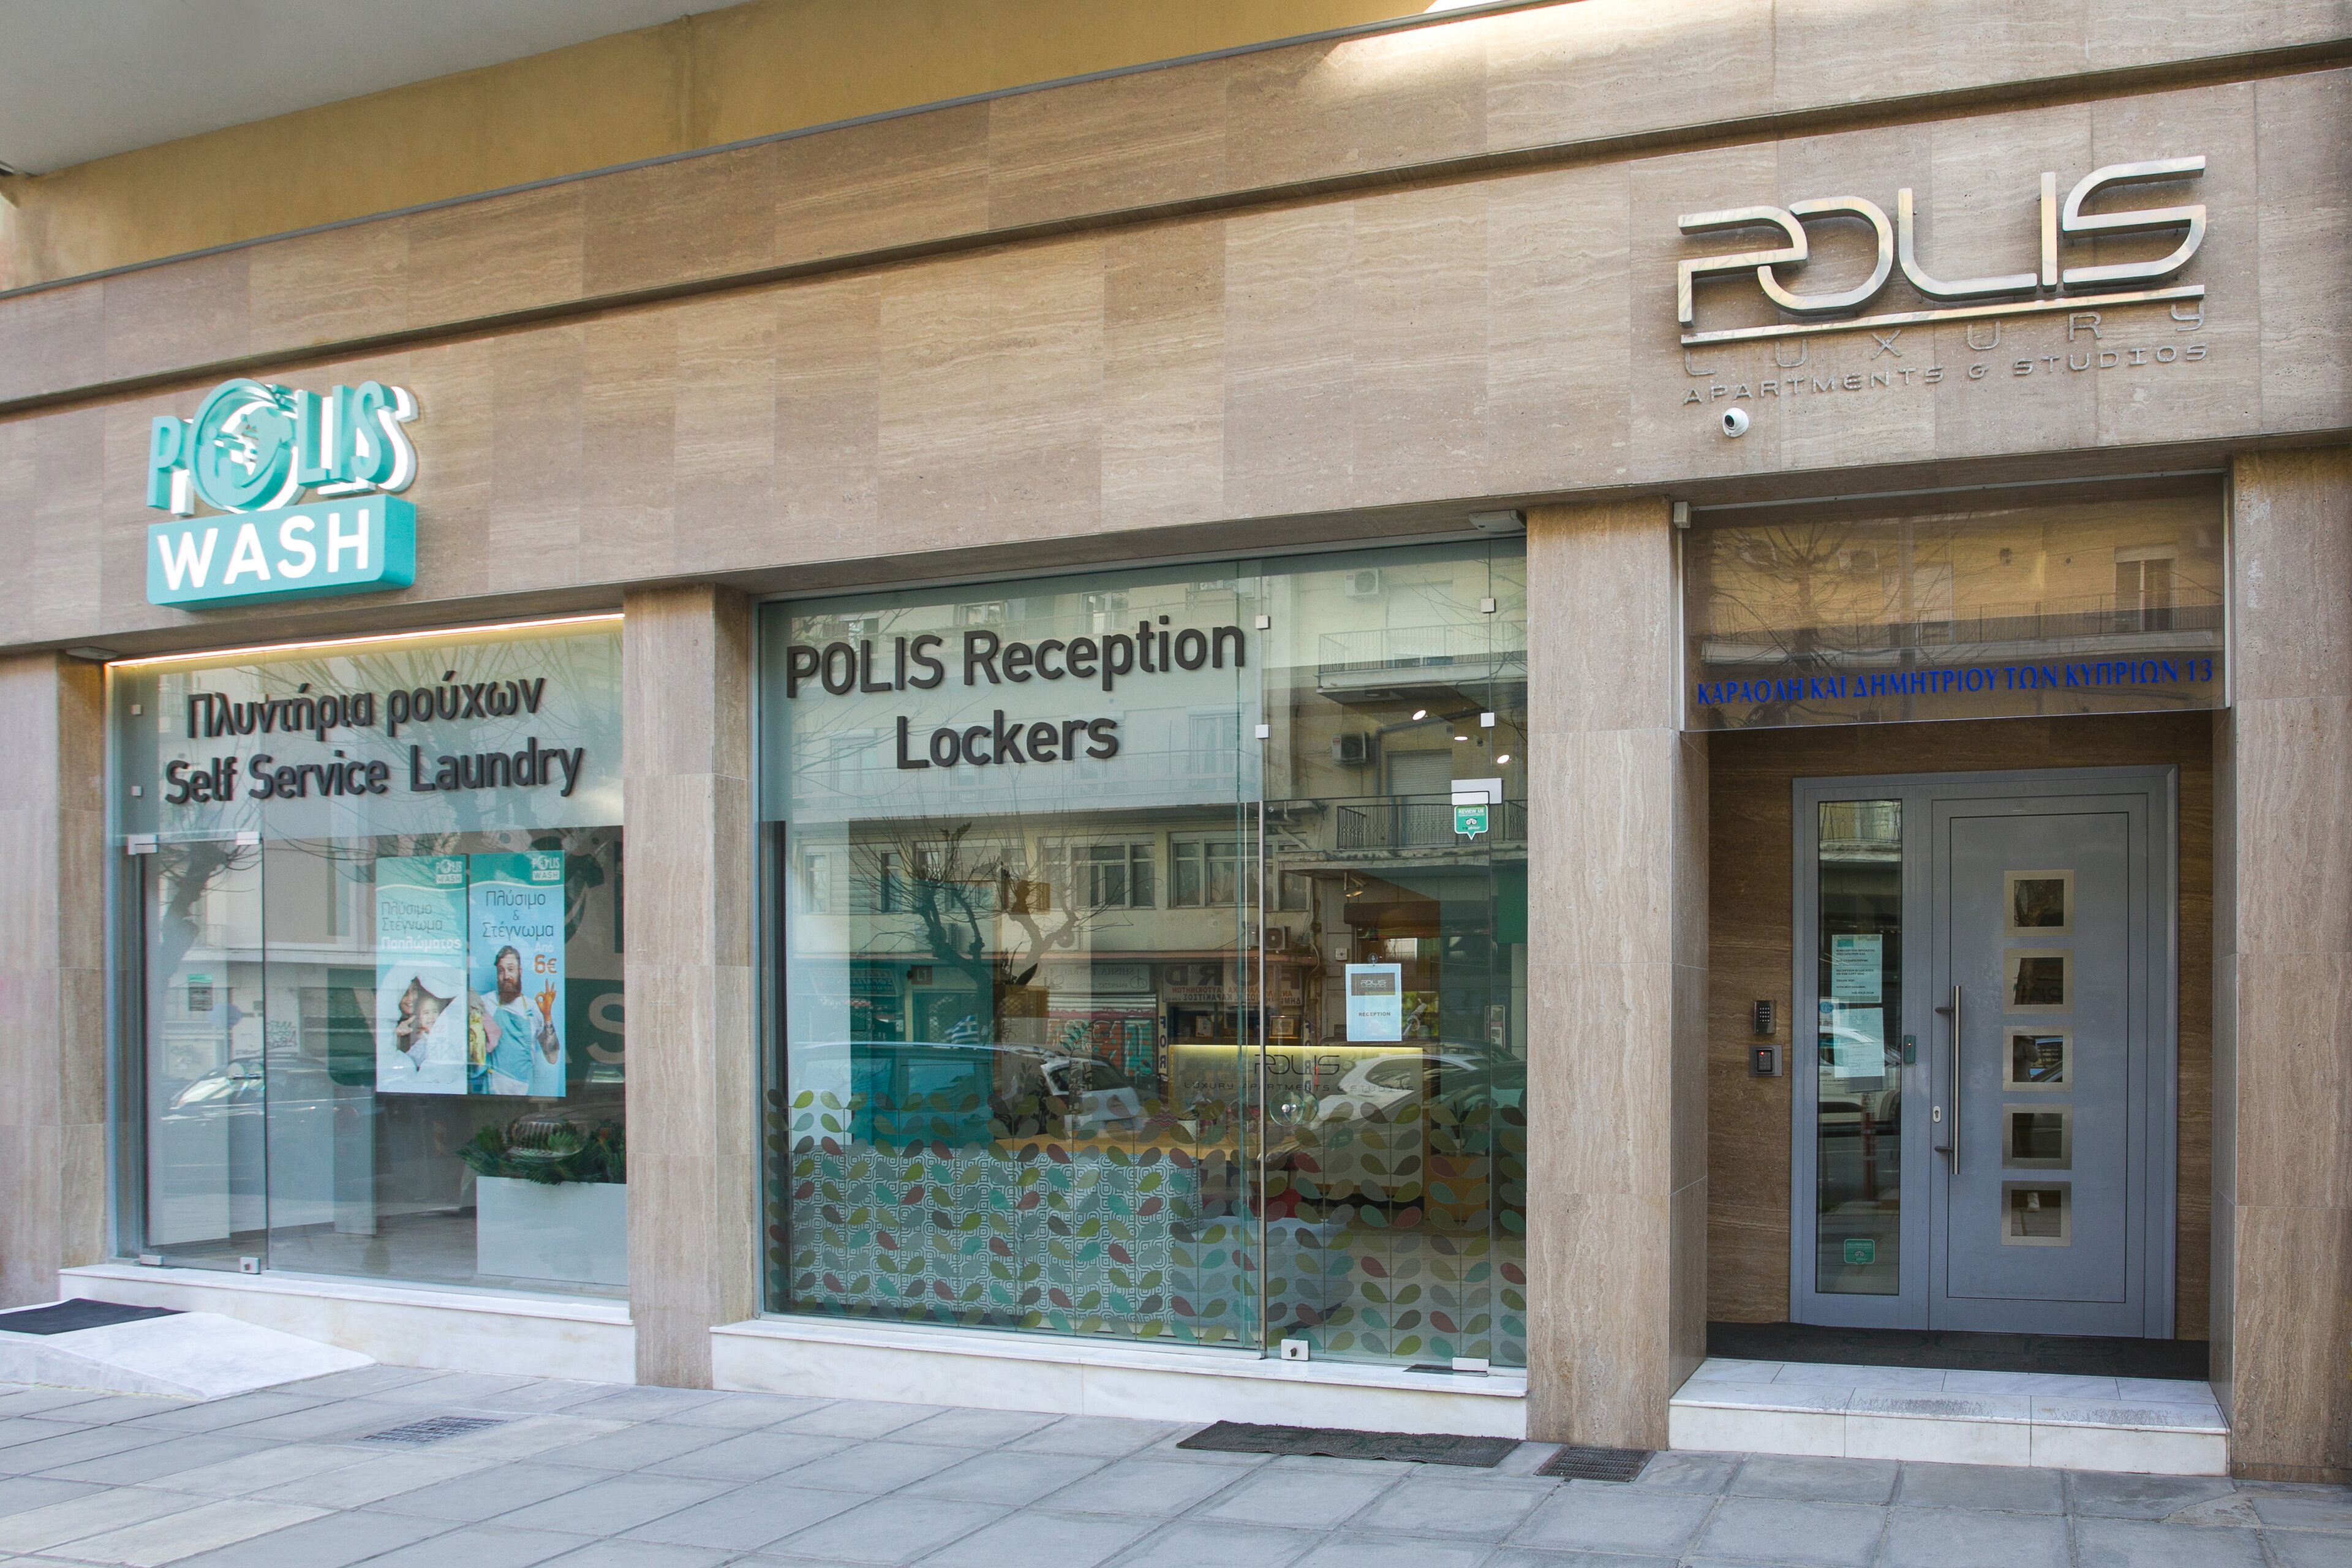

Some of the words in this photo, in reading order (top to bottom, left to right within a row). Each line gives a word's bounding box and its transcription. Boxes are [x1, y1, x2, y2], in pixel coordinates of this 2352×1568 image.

[1677, 155, 2206, 328] POLIS
[1684, 302, 2206, 375] LUXURY
[1683, 366, 1944, 405] APARTMENTS
[2013, 344, 2207, 375] STUDIOS
[147, 377, 418, 515] POLIS
[156, 508, 370, 592] WASH
[786, 634, 944, 699] POLIS
[963, 614, 1245, 692] Reception
[186, 683, 373, 742] Πλυντήρια
[386, 670, 546, 737] ρούχων
[1696, 678, 1803, 706] ΚΑΡΑΟΛΗ
[1809, 675, 1847, 701] ΚΑΙ
[1852, 667, 2000, 698] ΔΗΜΗΤΡΙΟΥ
[2003, 663, 2059, 690] ΤΩΝ
[2064, 660, 2179, 687] ΚΥΠΡΙΩΝ
[2185, 658, 2214, 684] 13
[897, 709, 1118, 771] Lockers
[165, 756, 236, 805] Self
[248, 750, 390, 802] Service
[409, 736, 584, 797] Laundry
[532, 855, 560, 870] POLIS
[381, 900, 432, 917] Πλύσιμο
[486, 890, 546, 909] Πλύσιμο
[513, 910, 519, 921] &
[381, 936, 461, 951] Παπλώματος
[382, 917, 443, 934] Στέγνωμα
[482, 922, 554, 941] Στέγνωμα
[533, 954, 557, 974] 6€
[1242, 1082, 1330, 1091] APRTMENTS
